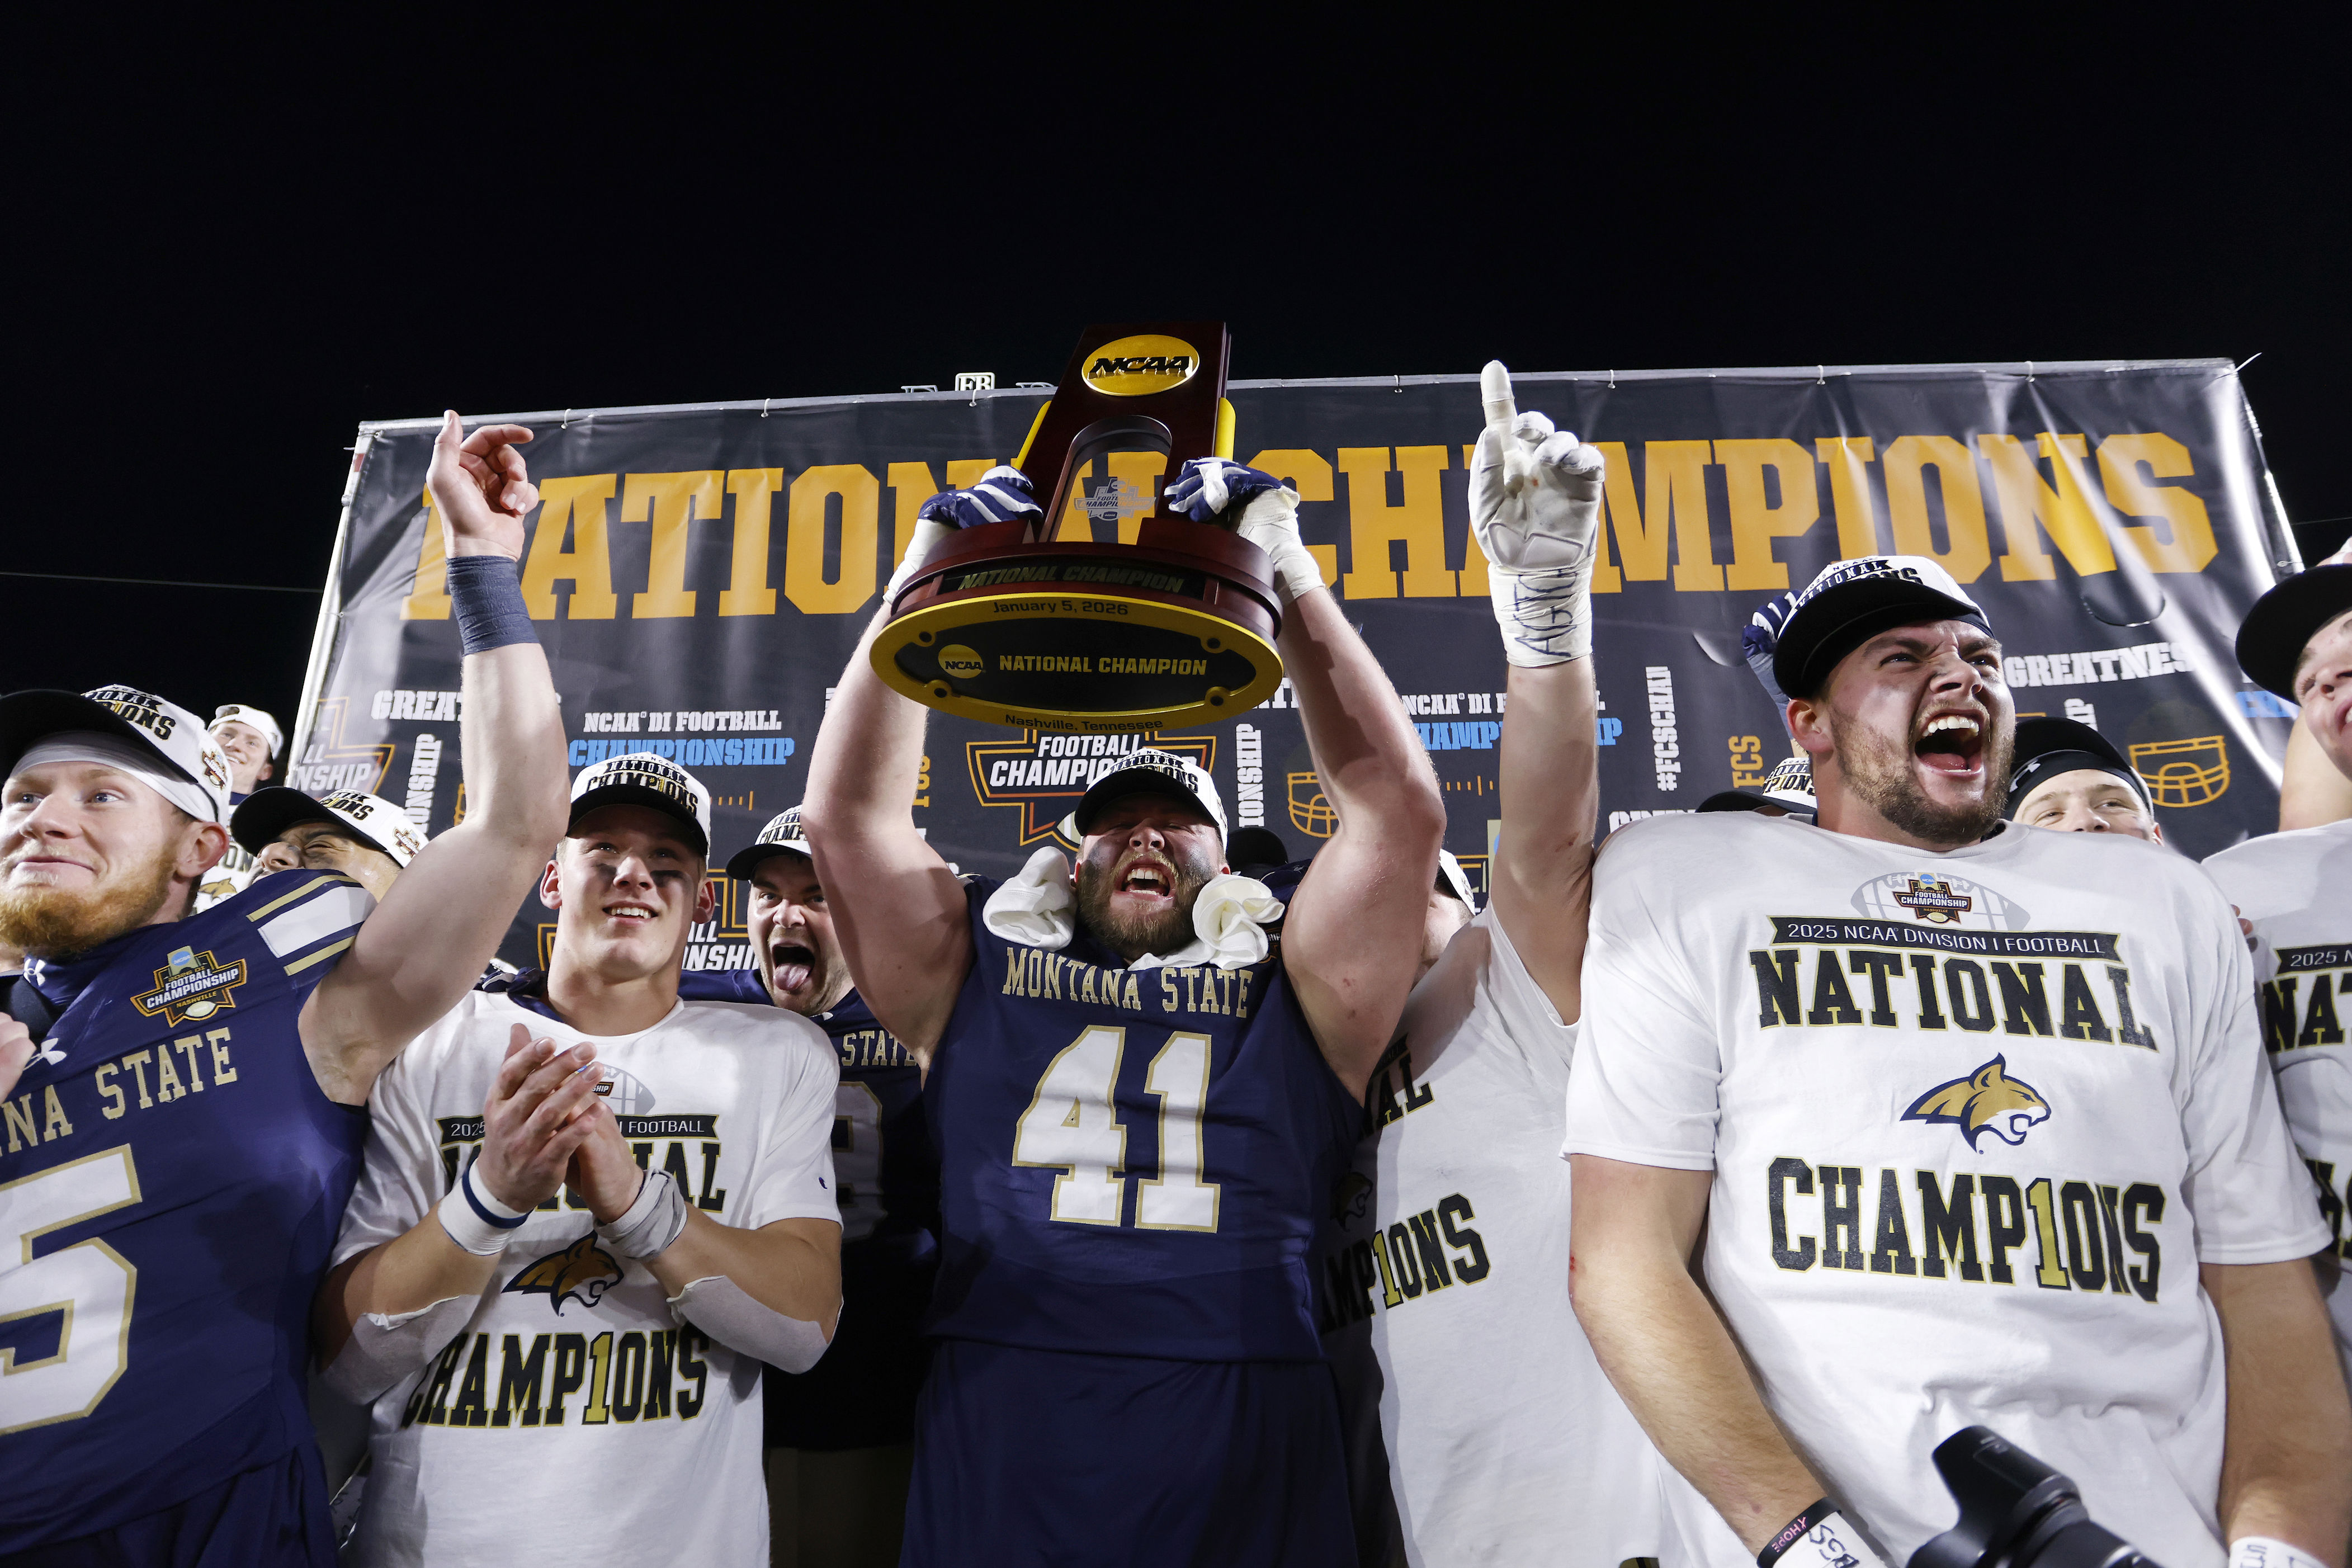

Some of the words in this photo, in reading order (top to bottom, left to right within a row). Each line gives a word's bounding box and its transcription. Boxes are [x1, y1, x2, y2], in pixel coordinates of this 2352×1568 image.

[1089, 356, 1192, 378] NCAA
[1244, 432, 2218, 599] CHMPIONS
[958, 566, 1057, 591] NATIONAL
[1062, 567, 1184, 593] CHAMPION
[993, 600, 1056, 616] January
[1062, 601, 1078, 615] 5,
[1082, 601, 1128, 615] 2026
[945, 661, 983, 670] NCAA
[999, 655, 1092, 673] NATIONAL
[1098, 657, 1207, 676] CHAMPION
[1468, 693, 1491, 714] DI
[649, 712, 671, 732] DI
[676, 710, 781, 731] FOOTBALL
[1005, 714, 1078, 731] Nashville,
[1081, 719, 1163, 730] Tennessee
[1038, 734, 1140, 757] FOOTBALL
[610, 760, 682, 783] NATIONAL
[1728, 735, 1765, 788] FCS
[1901, 896, 1968, 907] CHAMPIONSHIP
[1788, 924, 1838, 939] 2025
[1905, 928, 1989, 951] DIVISION
[2007, 938, 2106, 955] FOOTBALL
[2291, 950, 2337, 967] 2025
[147, 968, 239, 1008] CHAMPIONSHIP
[164, 969, 213, 991] FOOTBALL
[1002, 947, 1141, 1010] MONTANA
[1160, 966, 1254, 1018] STATE
[176, 991, 217, 1008] NASHVILLE
[1749, 948, 2160, 1053] NATIONAL
[95, 1027, 238, 1120] STATE
[629, 1120, 705, 1134] FOOTBALL
[1012, 1024, 1221, 1233] 41
[1772, 1524, 1801, 1553] HOPE
